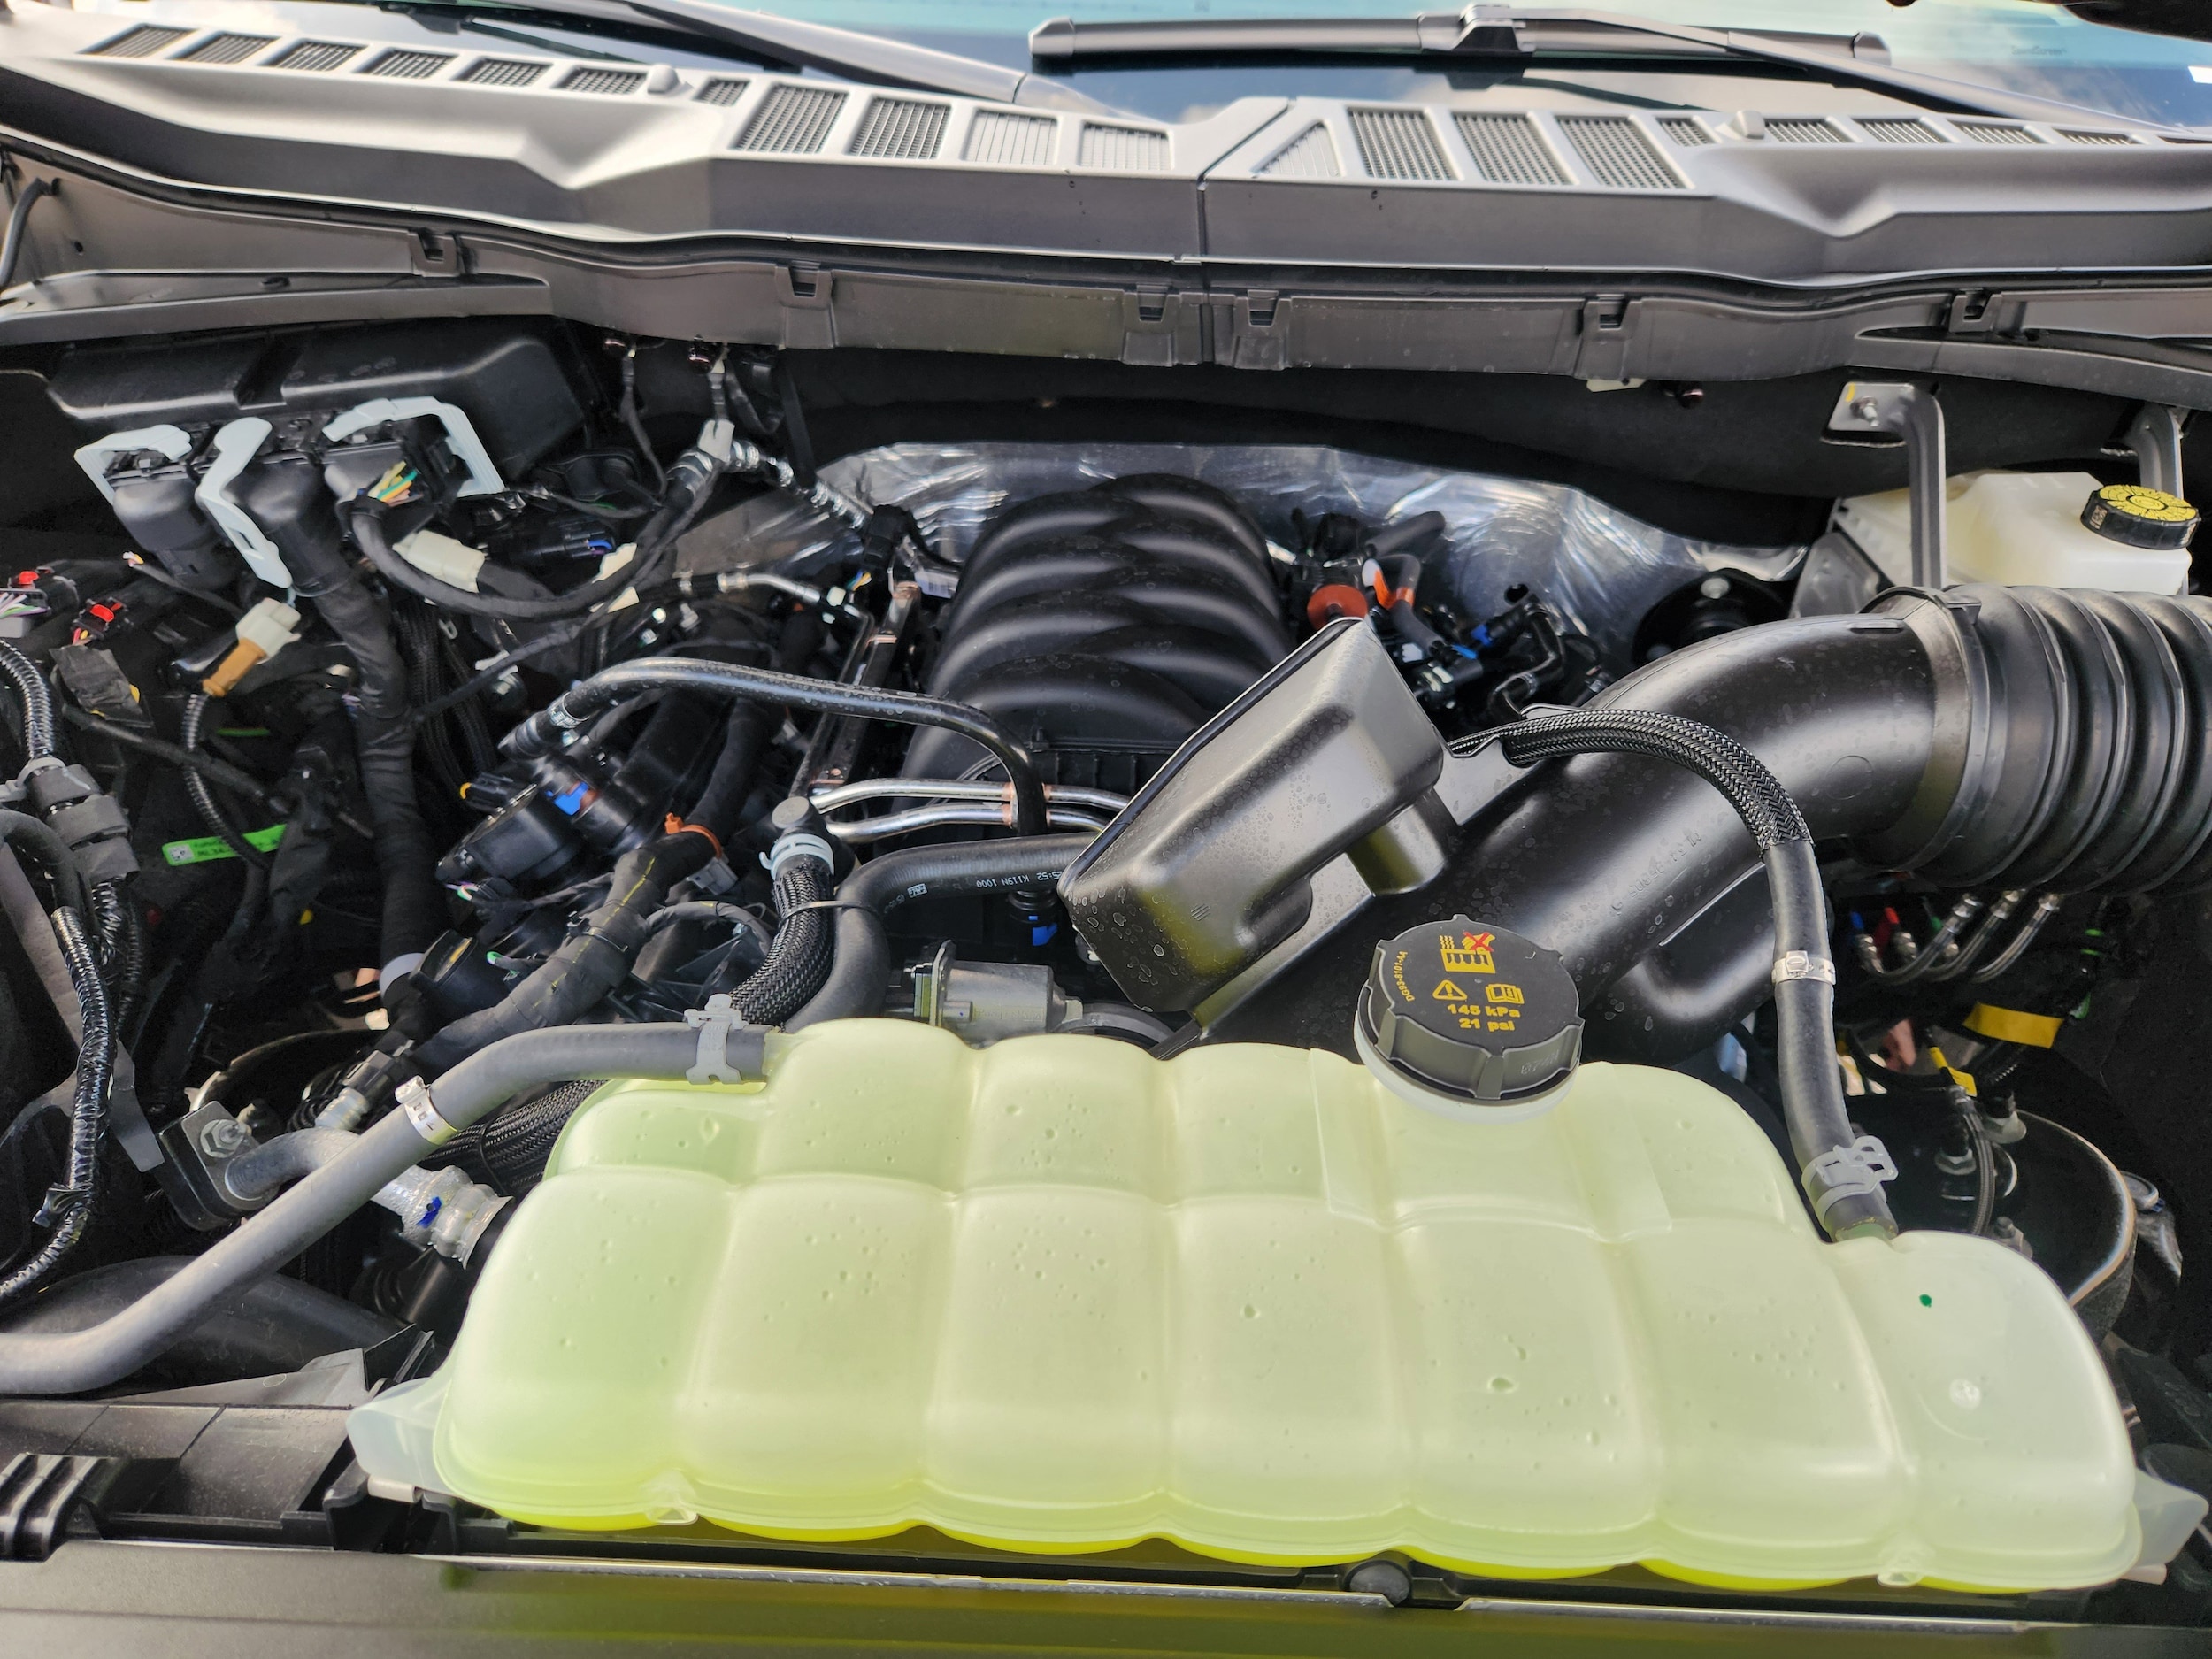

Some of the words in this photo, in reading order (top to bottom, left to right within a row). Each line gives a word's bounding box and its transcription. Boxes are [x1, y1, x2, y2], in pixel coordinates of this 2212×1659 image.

[976, 879, 997, 888] 1000
[1447, 1003, 1481, 1016] 145
[1485, 1005, 1521, 1018] kPa
[1458, 1018, 1481, 1029] 21
[1487, 1020, 1516, 1033] psi
